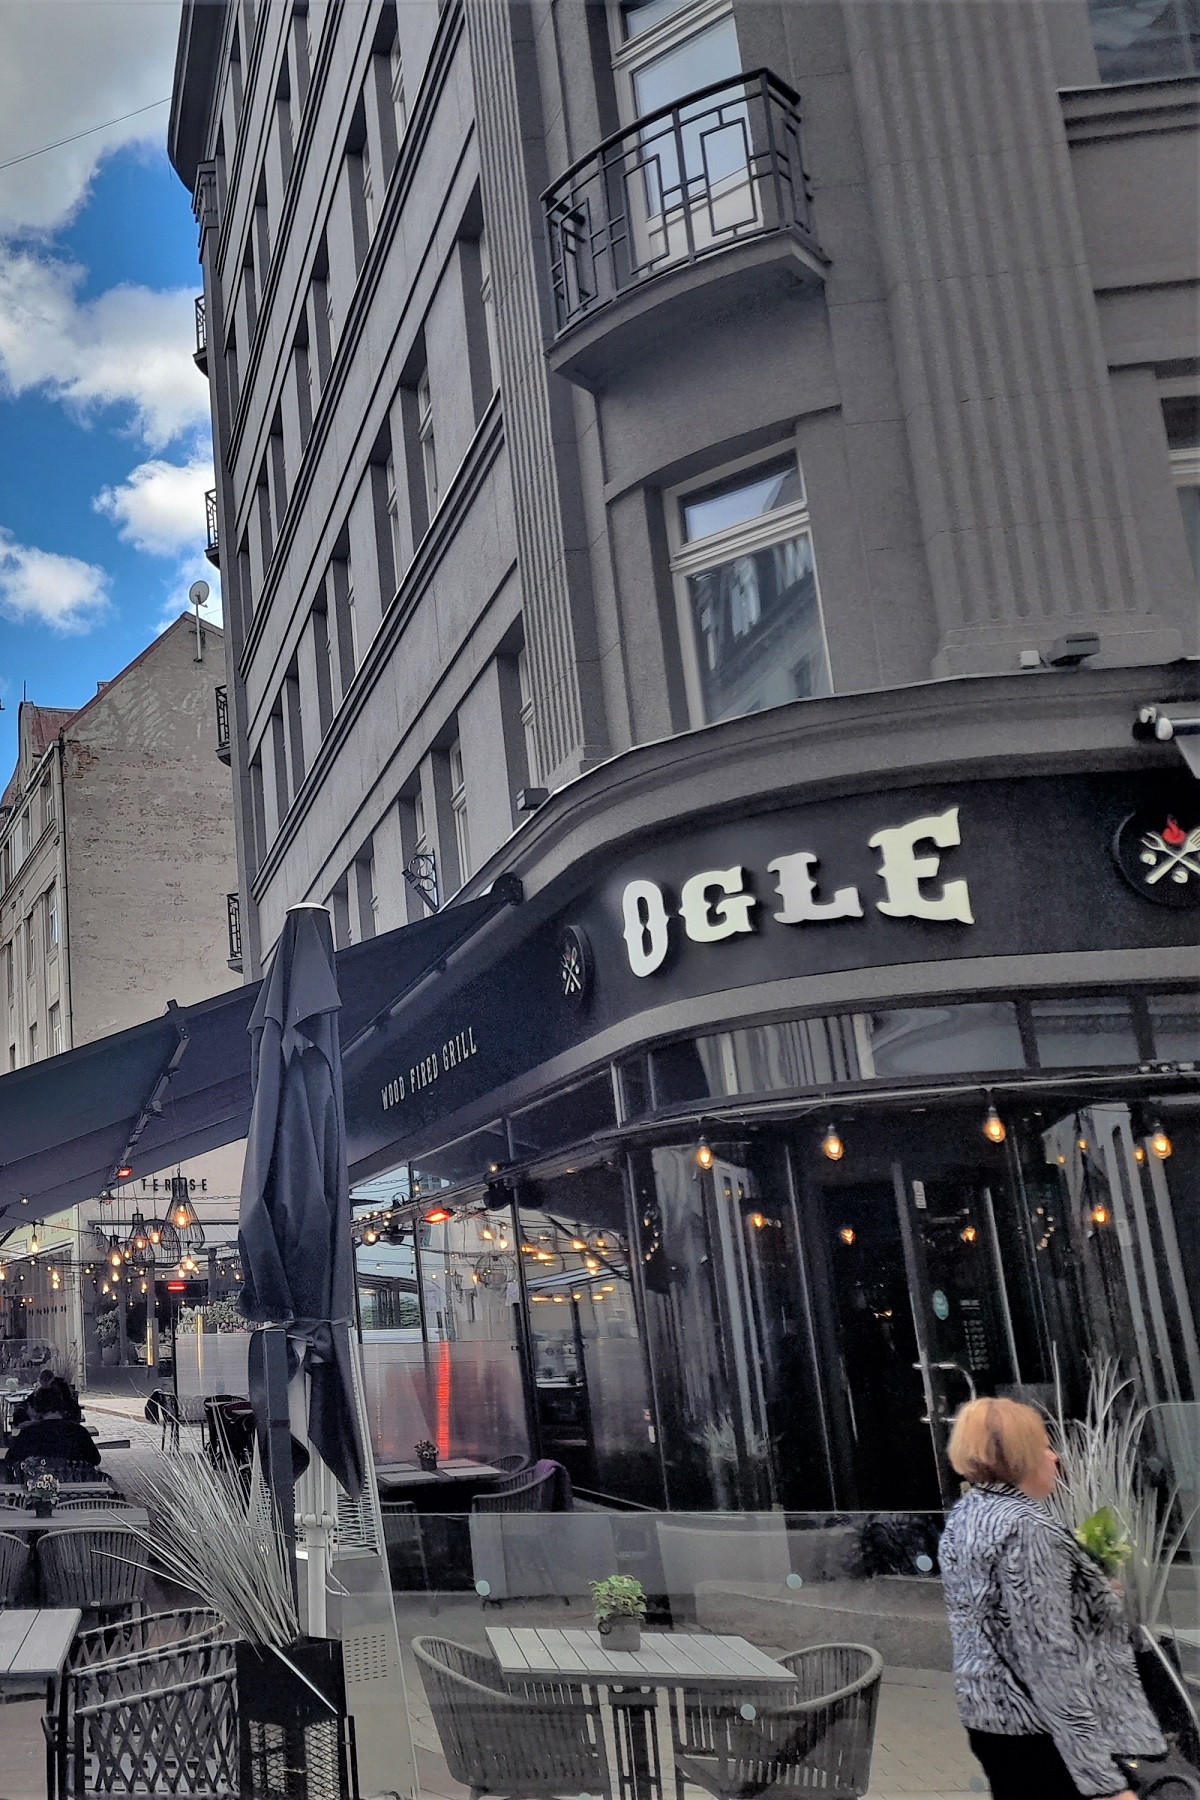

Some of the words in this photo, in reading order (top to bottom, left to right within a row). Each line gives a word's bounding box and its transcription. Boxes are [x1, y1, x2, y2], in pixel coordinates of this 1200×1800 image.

[622, 807, 975, 978] OGLE
[381, 1076, 406, 1111] WOOD
[410, 1053, 439, 1094] FIRED
[442, 1026, 477, 1072] GRILL
[141, 1178, 208, 1191] TERSE
